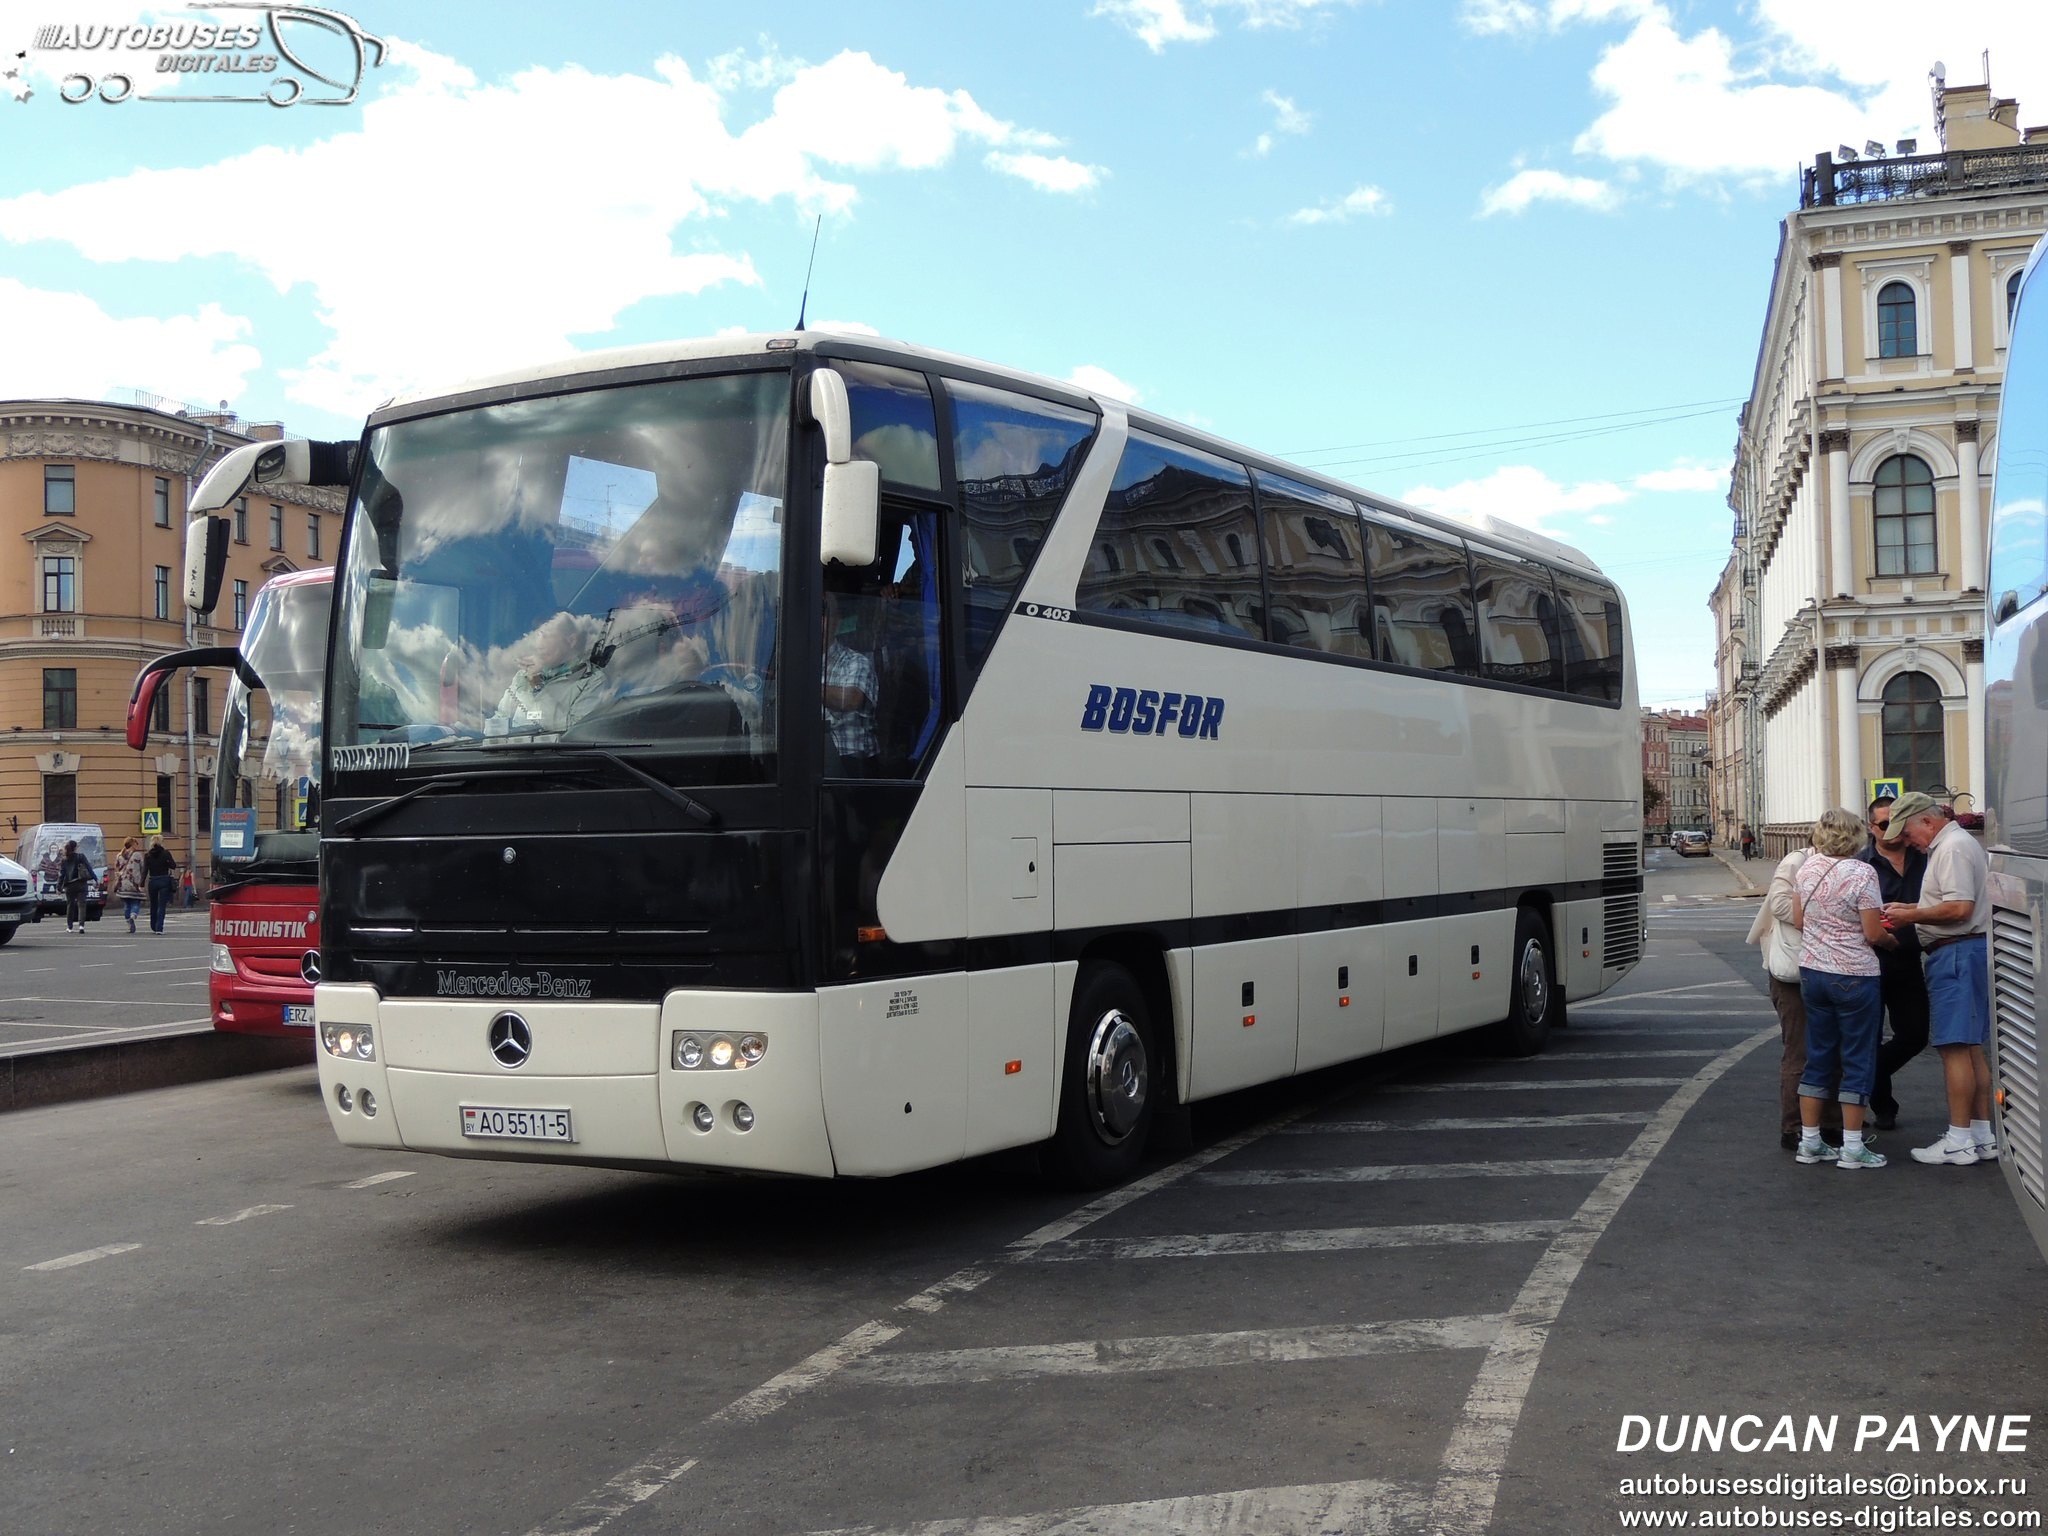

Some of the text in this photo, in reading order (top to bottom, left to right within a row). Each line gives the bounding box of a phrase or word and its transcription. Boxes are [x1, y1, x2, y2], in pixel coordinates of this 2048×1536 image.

[1042, 607, 1071, 621] 403
[1081, 684, 1225, 740] BOSFOR
[333, 743, 408, 771] ЗАКАЗНОЙ
[214, 919, 308, 939] BUSTOURISTIK
[436, 970, 592, 998] Mercedes-Benz
[288, 1008, 308, 1022] ERZ
[465, 1123, 475, 1132] BY
